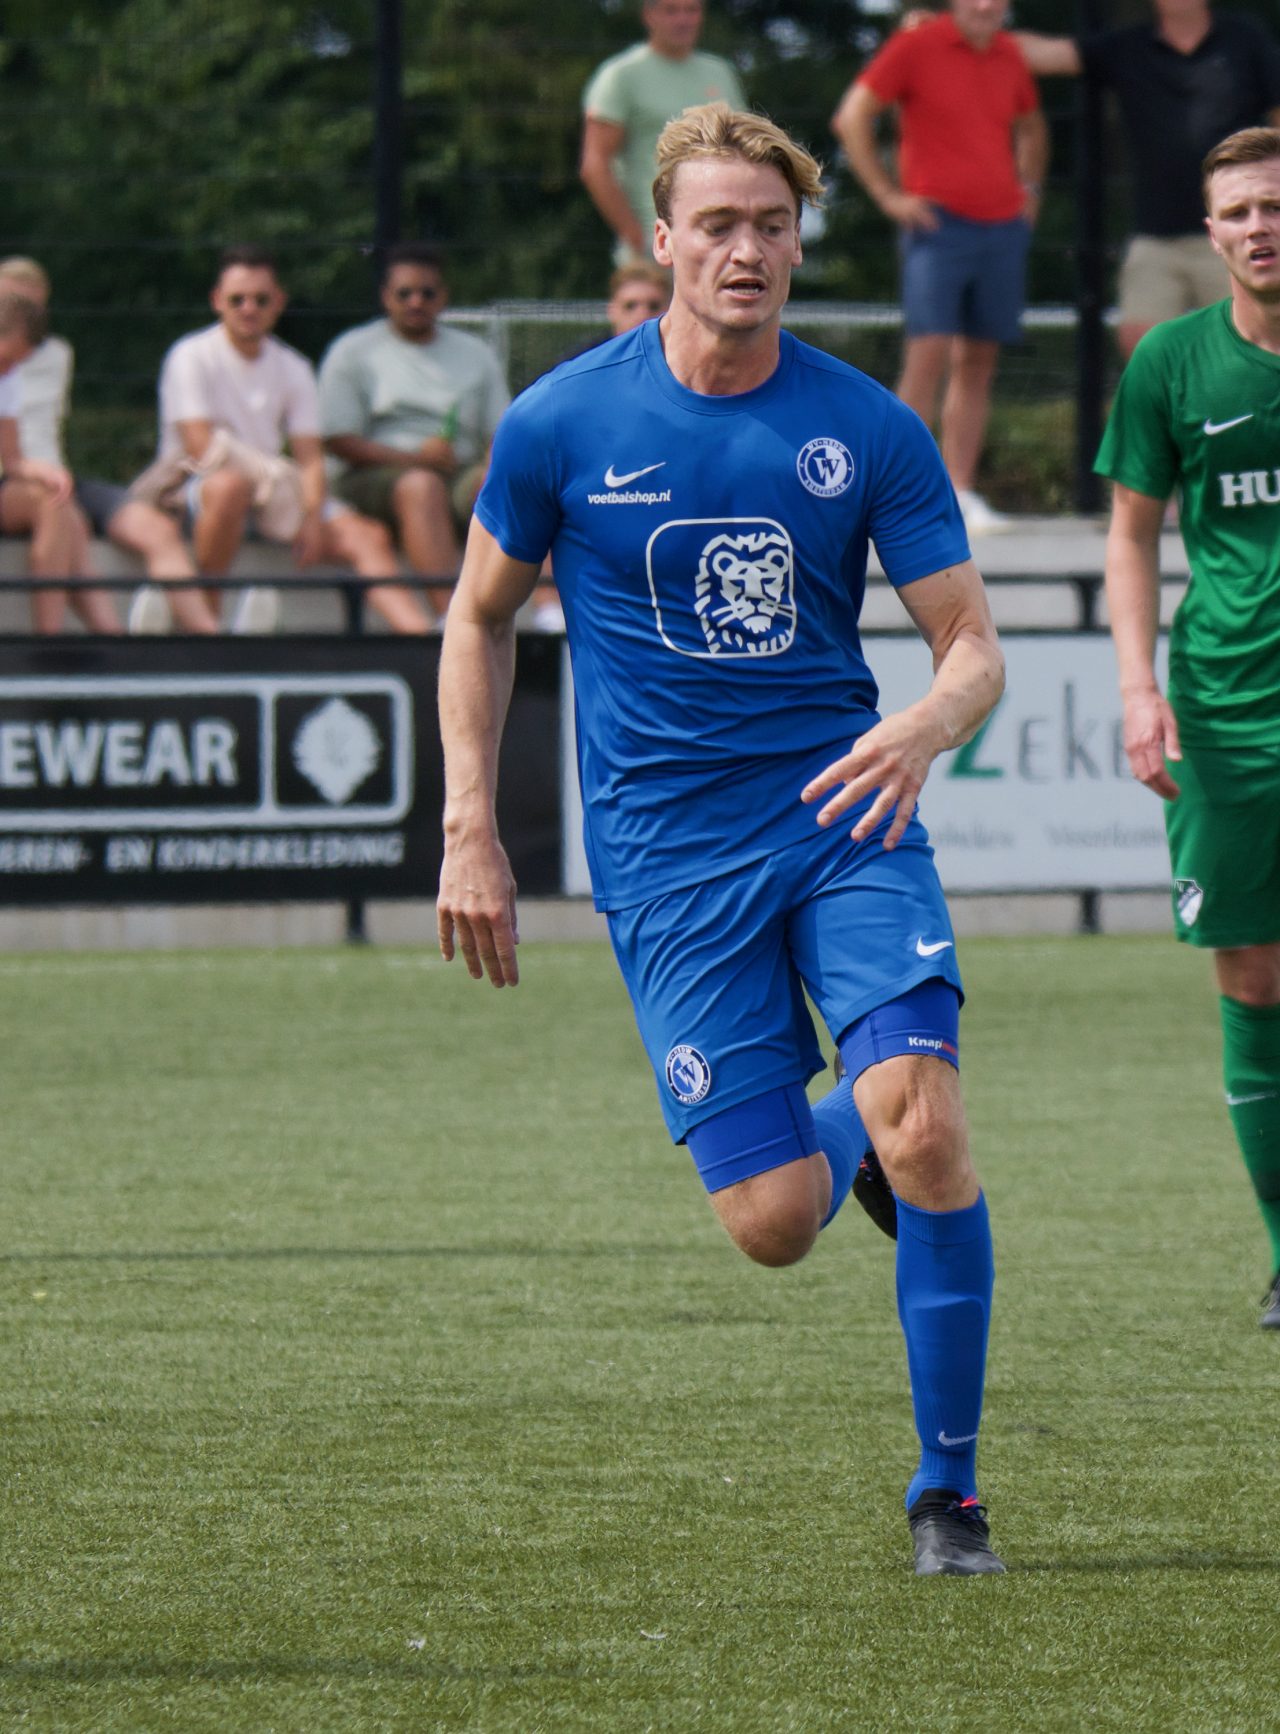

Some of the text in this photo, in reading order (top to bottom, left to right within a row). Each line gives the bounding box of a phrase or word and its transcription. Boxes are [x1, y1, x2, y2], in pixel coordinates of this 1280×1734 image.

[587, 488, 671, 505] voetbalshop.nl
[0, 719, 239, 787] EWEAR
[107, 834, 153, 873] EN
[157, 831, 404, 872] KINDERKLEDING
